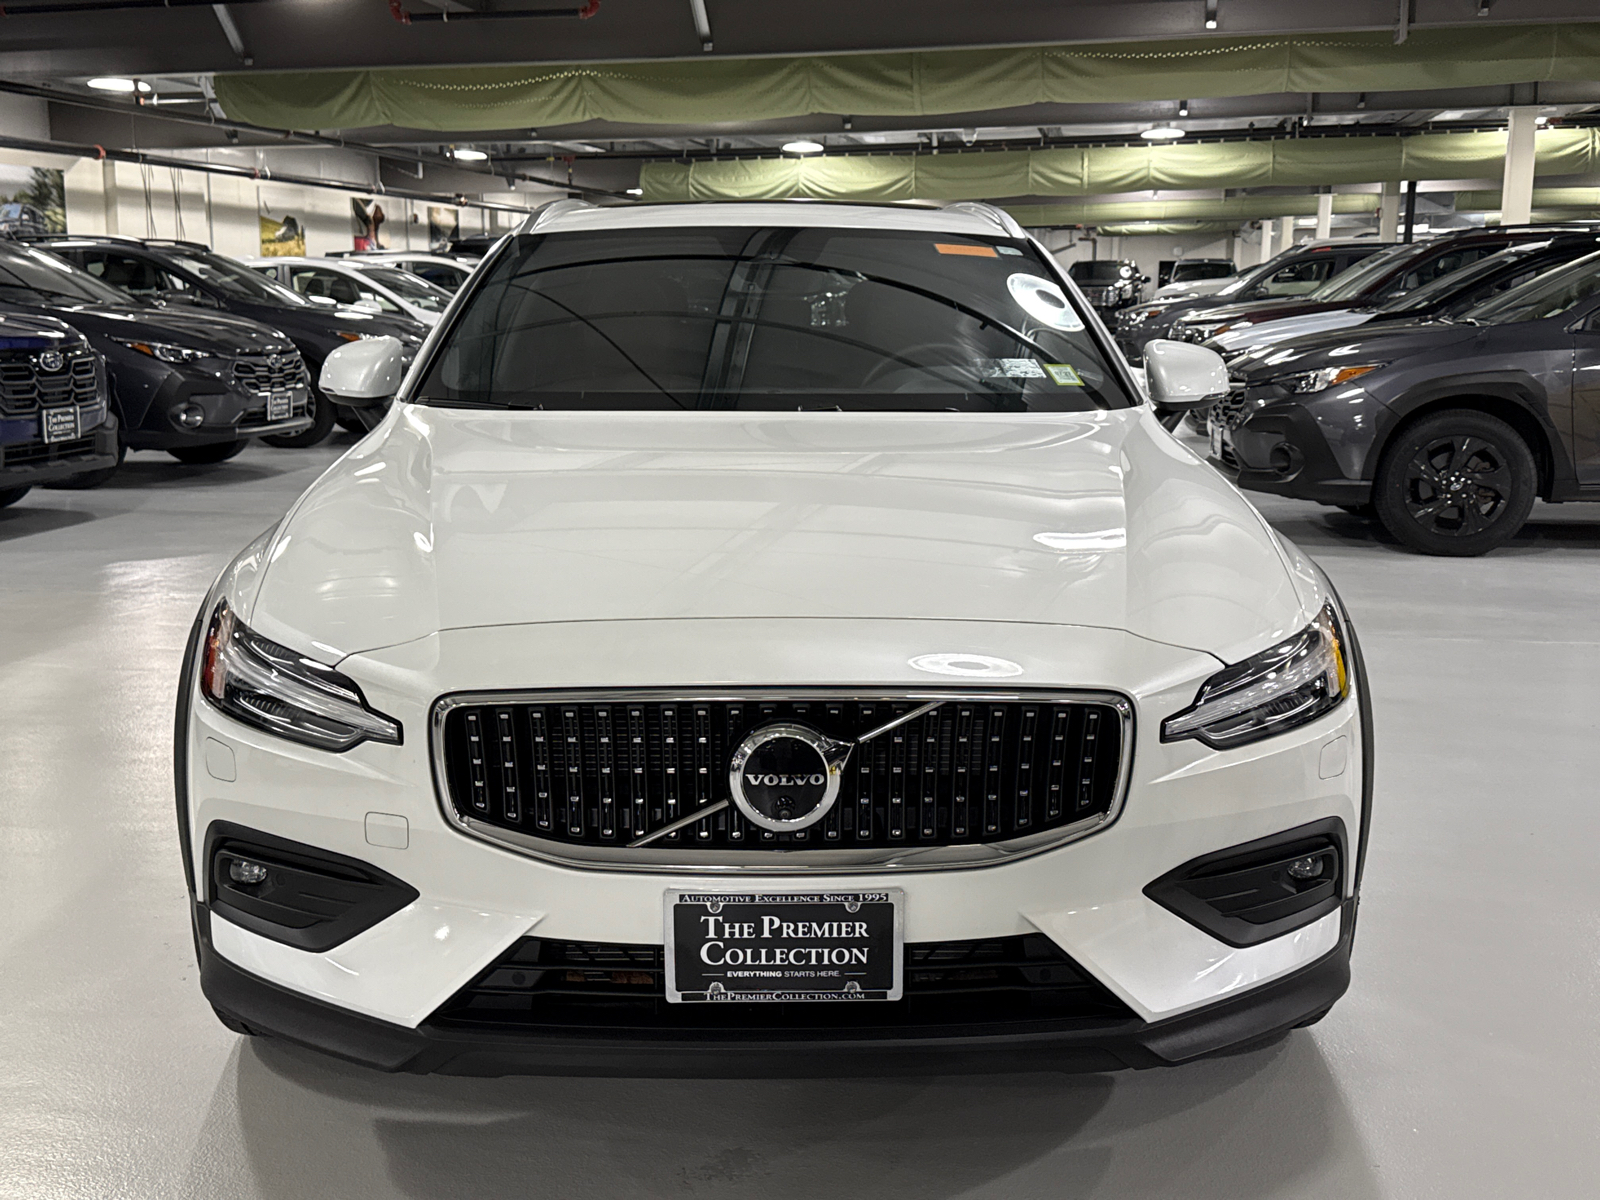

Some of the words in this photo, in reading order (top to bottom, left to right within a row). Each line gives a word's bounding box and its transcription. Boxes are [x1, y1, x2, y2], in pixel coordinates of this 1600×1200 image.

[745, 774, 825, 786] VOLVO
[682, 894, 751, 903] AUTOMOTIVE
[755, 893, 819, 903] EXCELLENCE
[823, 893, 855, 903] SINCE
[858, 893, 887, 902] 1995
[700, 915, 756, 939] THE
[760, 915, 870, 939] PREMIER
[700, 941, 870, 966] COLLECTION
[726, 970, 782, 978] EVERYTHING
[784, 970, 816, 978] STARTS
[816, 970, 842, 978] HERE.
[703, 991, 866, 1001] THEPREMIERCOLLECTION.COM
